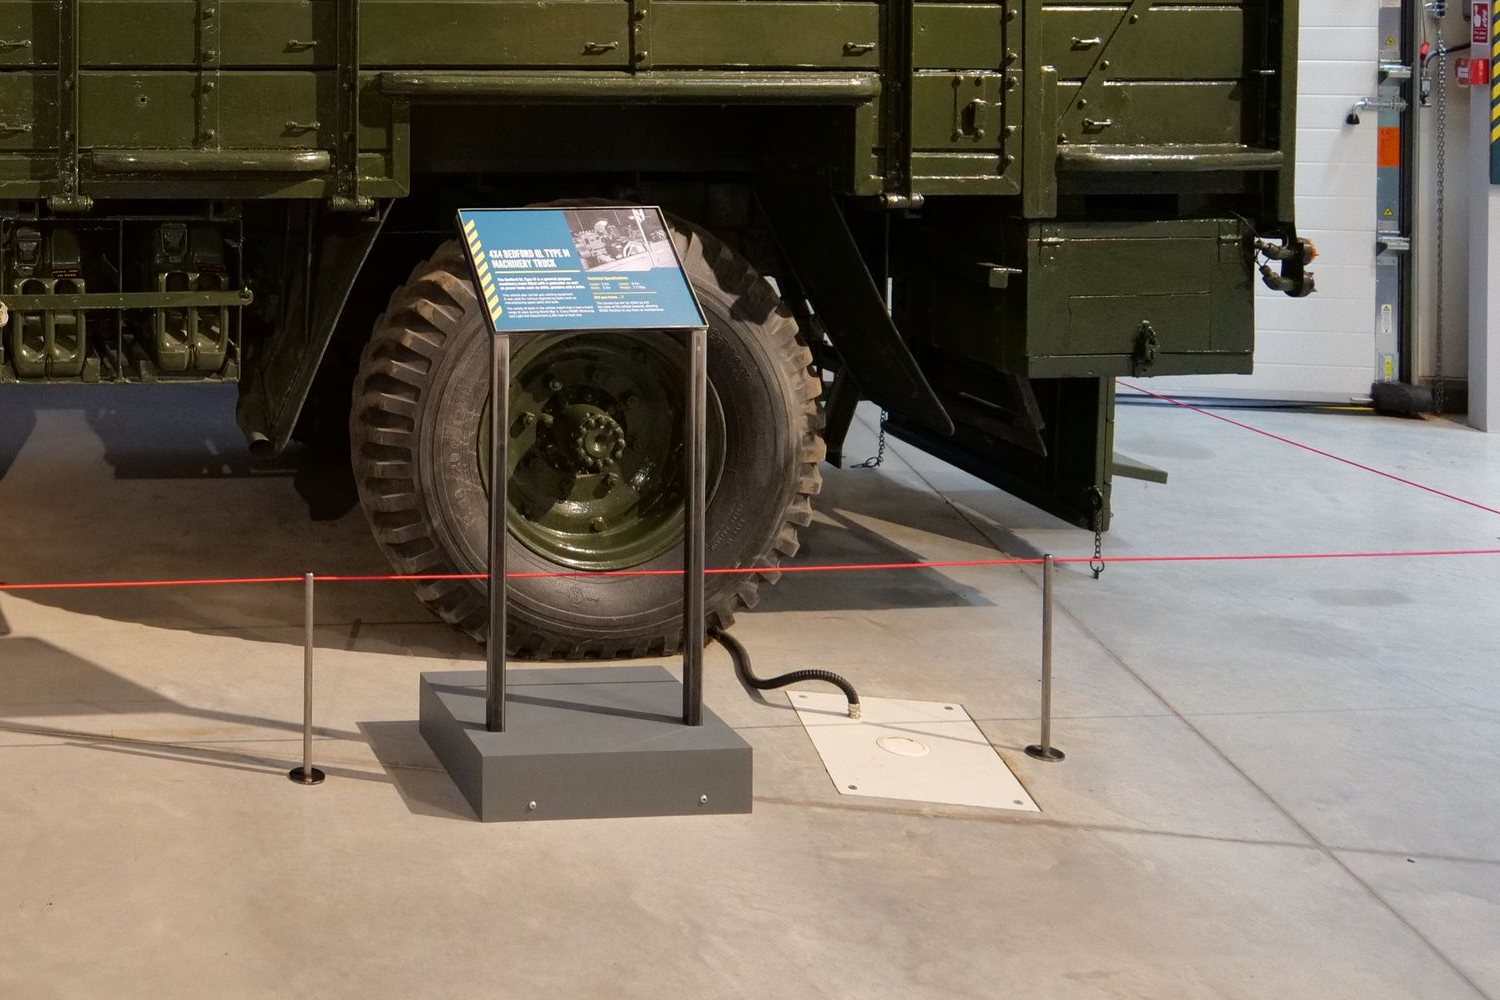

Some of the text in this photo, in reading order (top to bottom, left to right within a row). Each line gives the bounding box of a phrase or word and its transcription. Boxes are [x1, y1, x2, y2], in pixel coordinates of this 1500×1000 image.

[489, 249, 571, 258] 4X4 BEDFORD QL TYPE M
[492, 259, 557, 268] MACHINERY TRUCK
